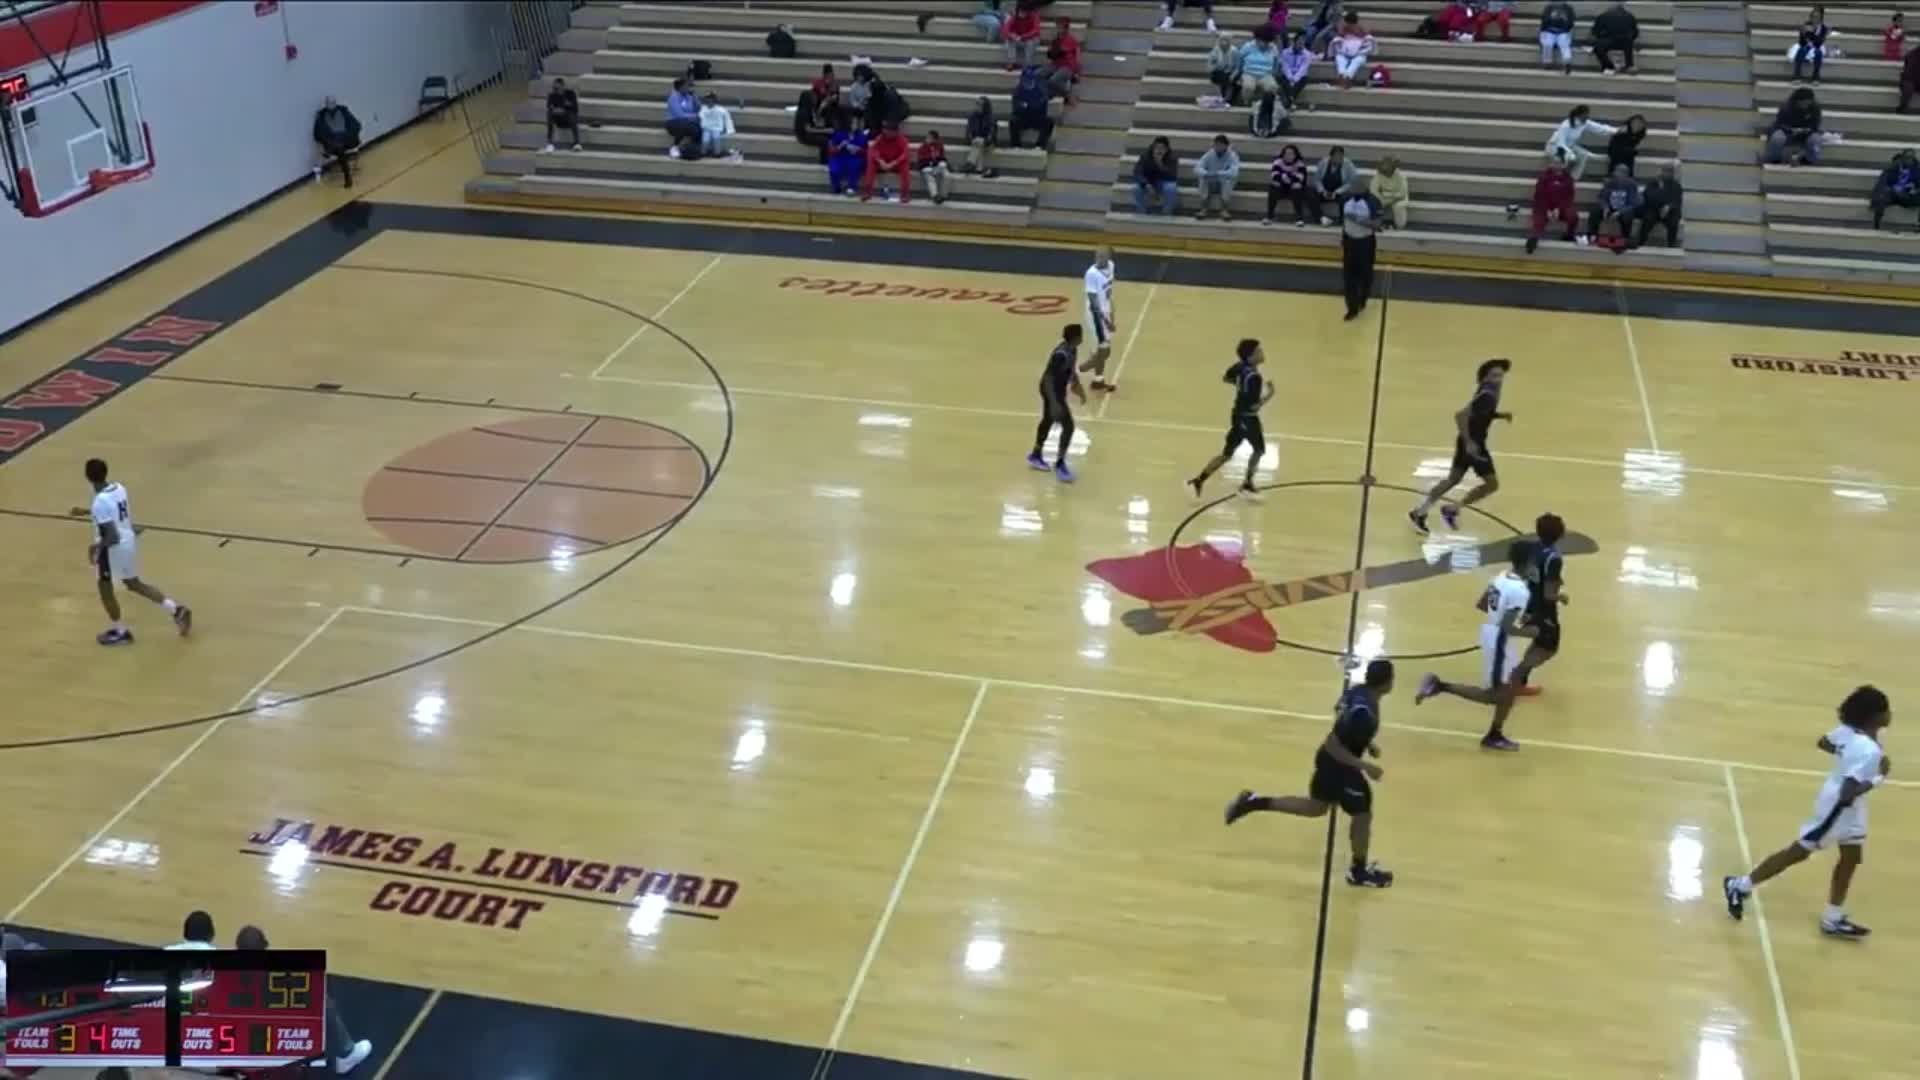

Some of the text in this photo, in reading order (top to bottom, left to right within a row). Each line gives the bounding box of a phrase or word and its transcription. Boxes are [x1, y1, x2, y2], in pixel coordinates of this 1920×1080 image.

[1730, 357, 1911, 381] LUNSFORD
[1839, 350, 1920, 367] OURT
[247, 818, 739, 909] JAMES A. LUNSFORD
[370, 881, 545, 930] COURT
